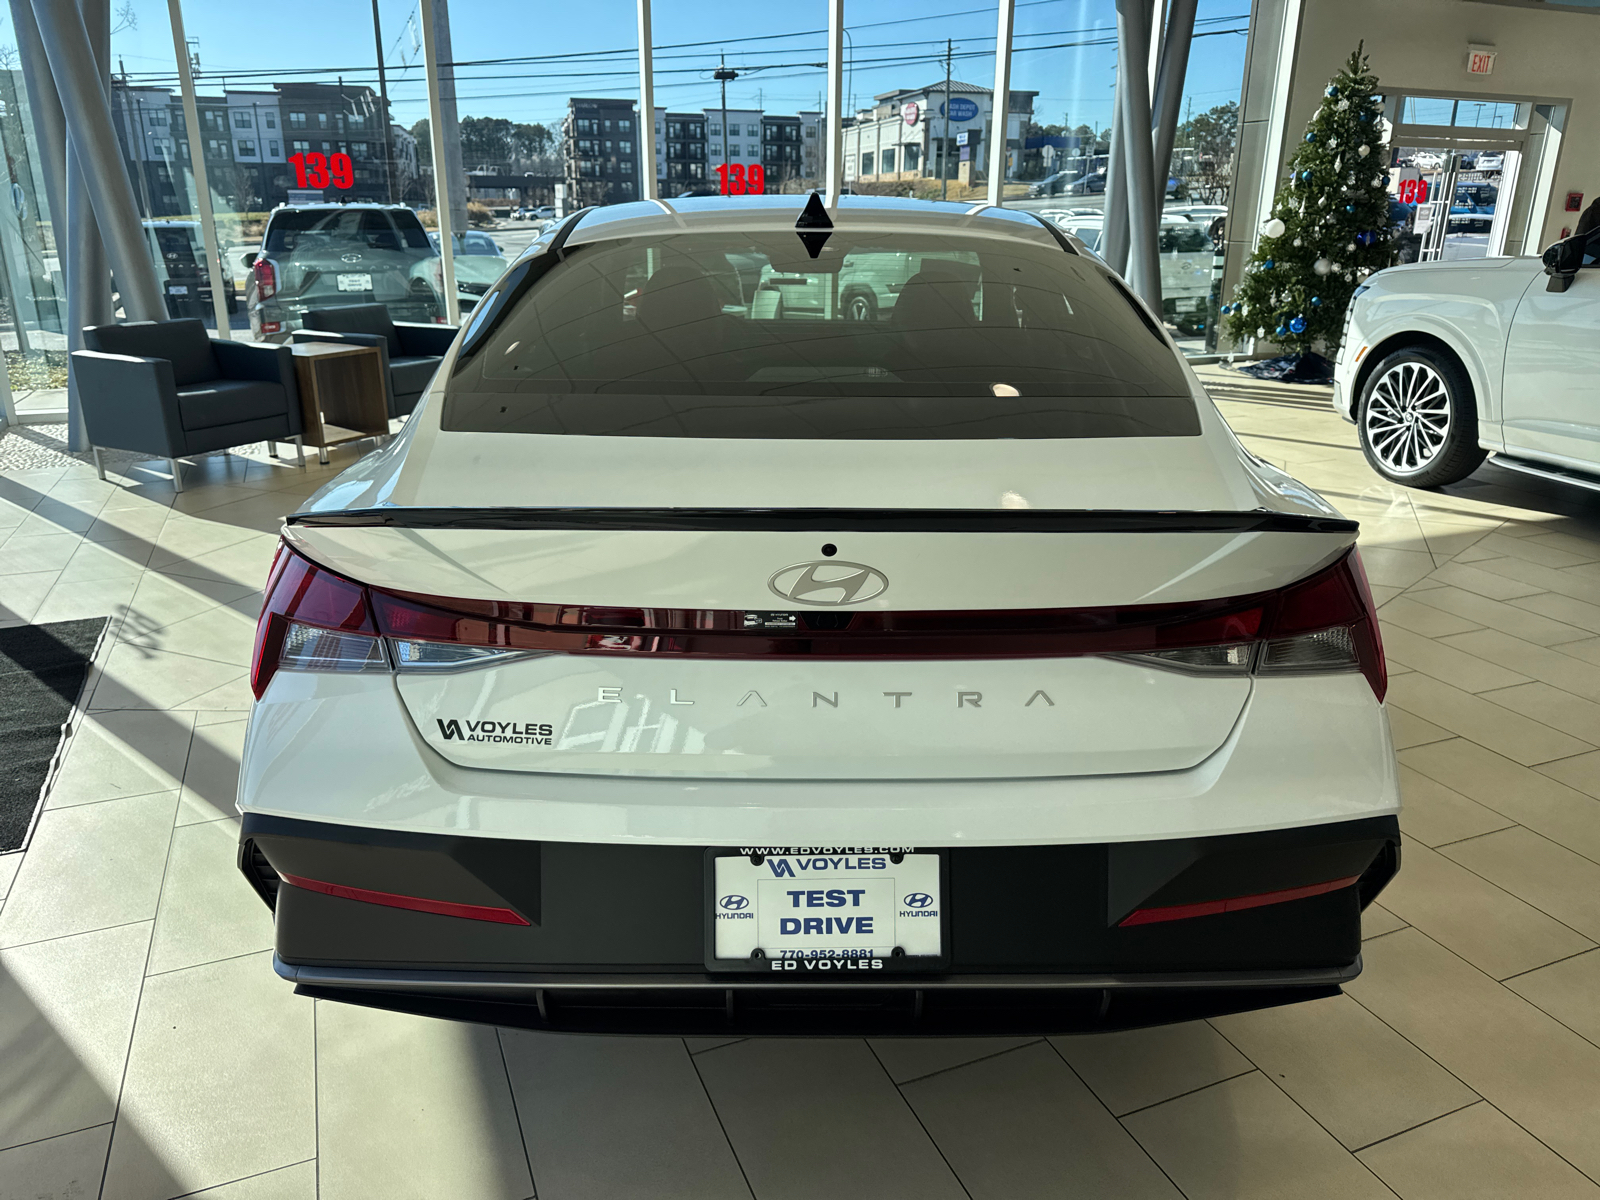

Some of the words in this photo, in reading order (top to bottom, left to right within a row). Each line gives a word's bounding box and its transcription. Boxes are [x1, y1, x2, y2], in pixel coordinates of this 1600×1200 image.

[1471, 54, 1491, 73] EXIT
[288, 152, 354, 189] 139
[715, 163, 765, 195] 139
[1399, 179, 1428, 204] 139
[598, 686, 1055, 708] ELANTRA
[465, 720, 553, 737] VOYLES
[467, 733, 553, 746] AUTOMOTIVE
[740, 846, 915, 855] WWW.EDVOYLES.COM
[795, 857, 887, 871] VOYLES
[786, 889, 866, 908] TEST
[714, 912, 754, 920] HYUNDAI
[780, 916, 874, 935] DRIVE
[780, 949, 874, 958] 770-952-8881
[771, 960, 797, 971] ED
[804, 959, 883, 970] VOYLES
